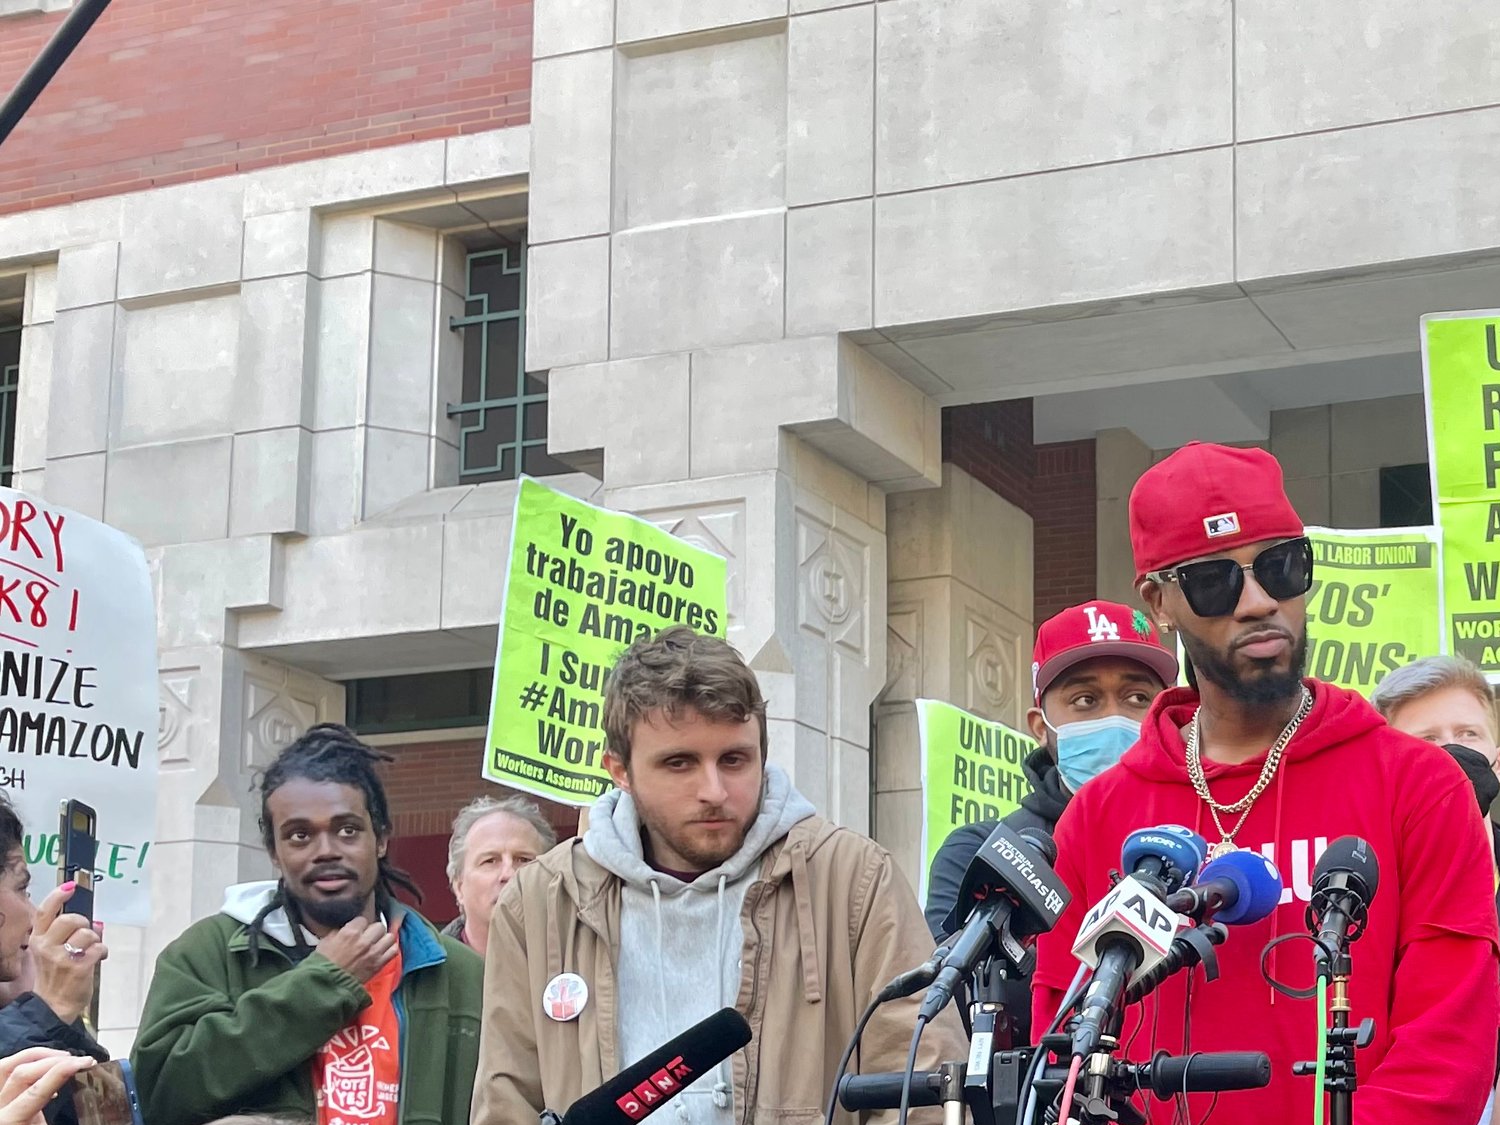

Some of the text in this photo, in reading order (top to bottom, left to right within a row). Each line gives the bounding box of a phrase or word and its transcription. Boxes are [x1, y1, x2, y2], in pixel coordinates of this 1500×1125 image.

[560, 512, 694, 589] Yo apoyo
[1327, 544, 1371, 565] LABOR
[1375, 545, 1416, 565] UNION
[526, 542, 718, 635] trabajadores
[533, 588, 661, 647] de Ama
[1083, 607, 1120, 641] LA
[540, 643, 549, 676] I
[0, 711, 144, 769] AMAZON
[496, 751, 545, 782] Workers
[545, 767, 604, 796] Assembly
[1000, 837, 1034, 869] SPECTRUM
[1140, 836, 1176, 849] WDR
[1122, 894, 1172, 932] AP
[333, 1076, 367, 1091] VOTE
[336, 1090, 367, 1108] YES
[624, 1062, 694, 1114] WNYC
